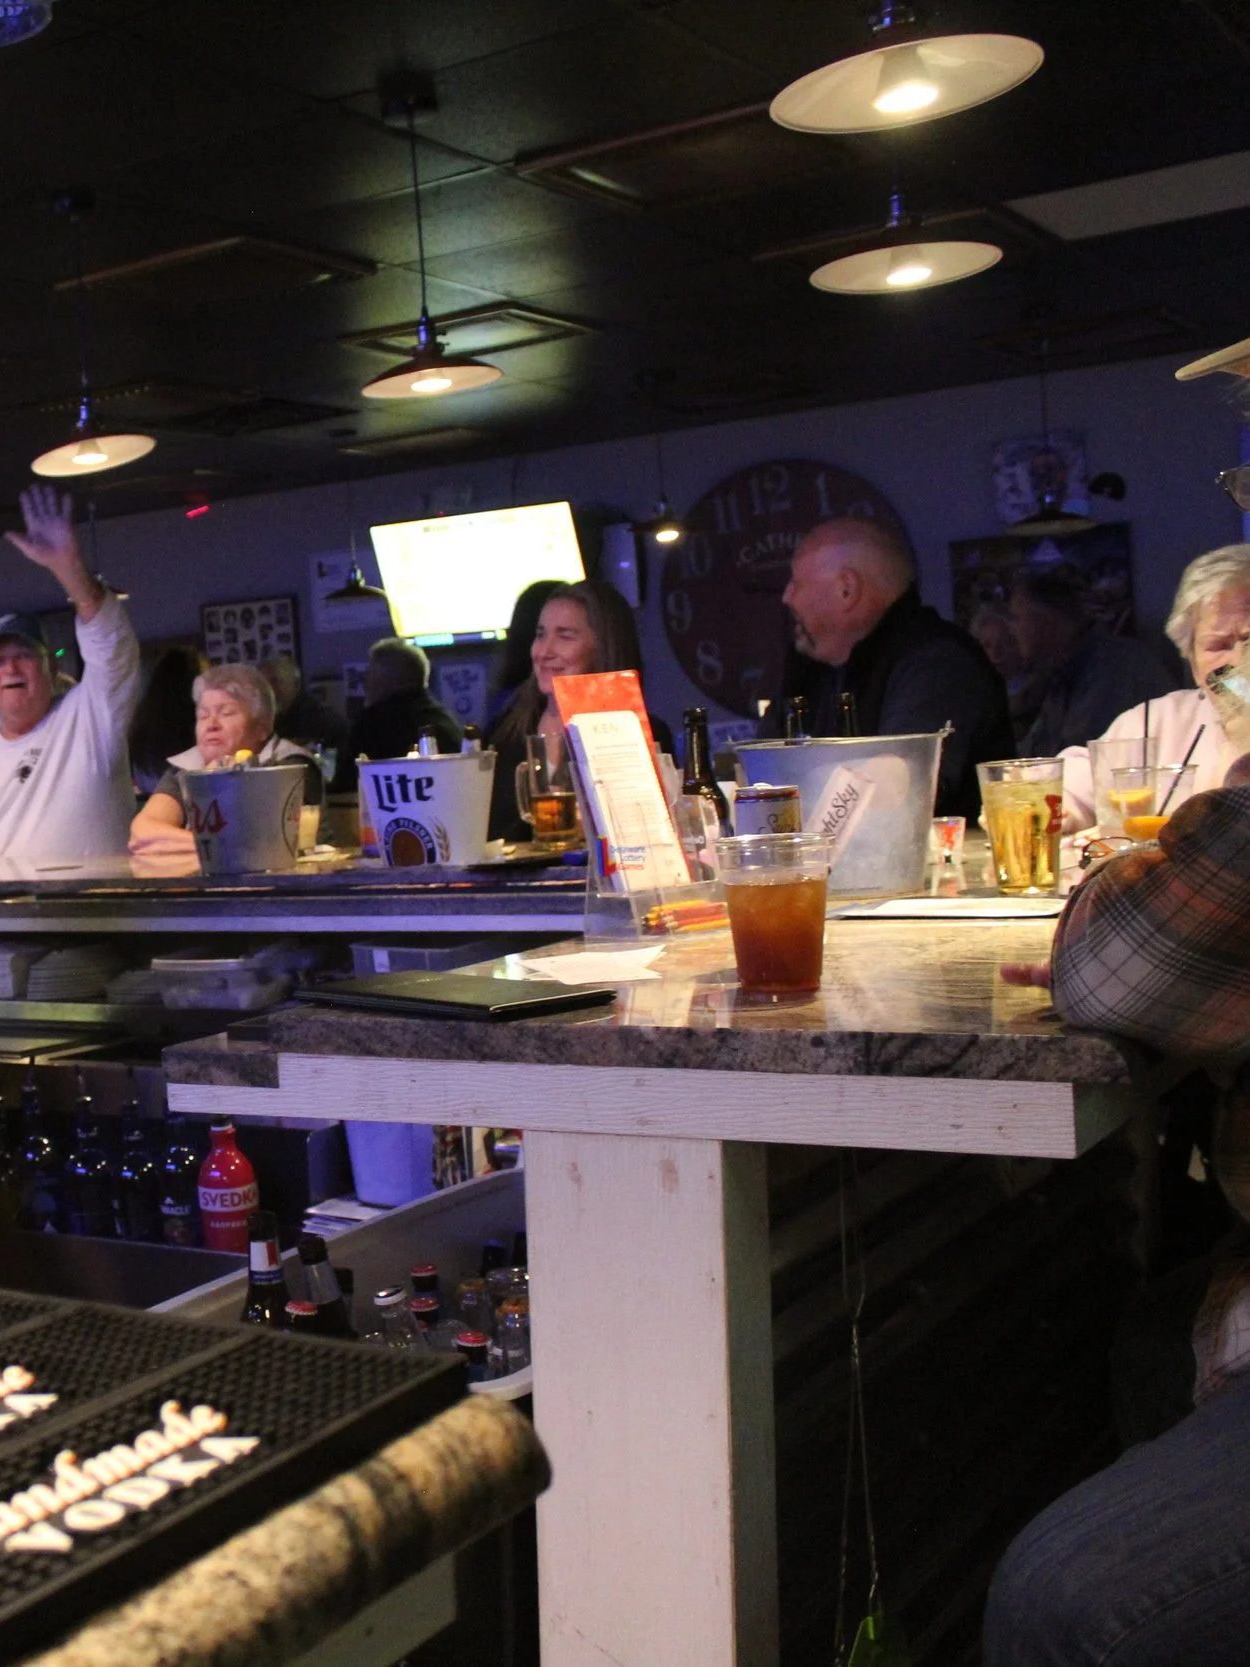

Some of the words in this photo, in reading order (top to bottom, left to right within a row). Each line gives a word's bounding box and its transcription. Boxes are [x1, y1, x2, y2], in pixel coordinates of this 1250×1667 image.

[713, 492, 741, 535] 11
[748, 465, 791, 517] 12
[665, 589, 693, 634] 9
[696, 639, 724, 685] 8
[370, 772, 435, 813] Lite
[398, 818, 433, 849] PILSNER
[4, 1436, 261, 1552] VODKA
